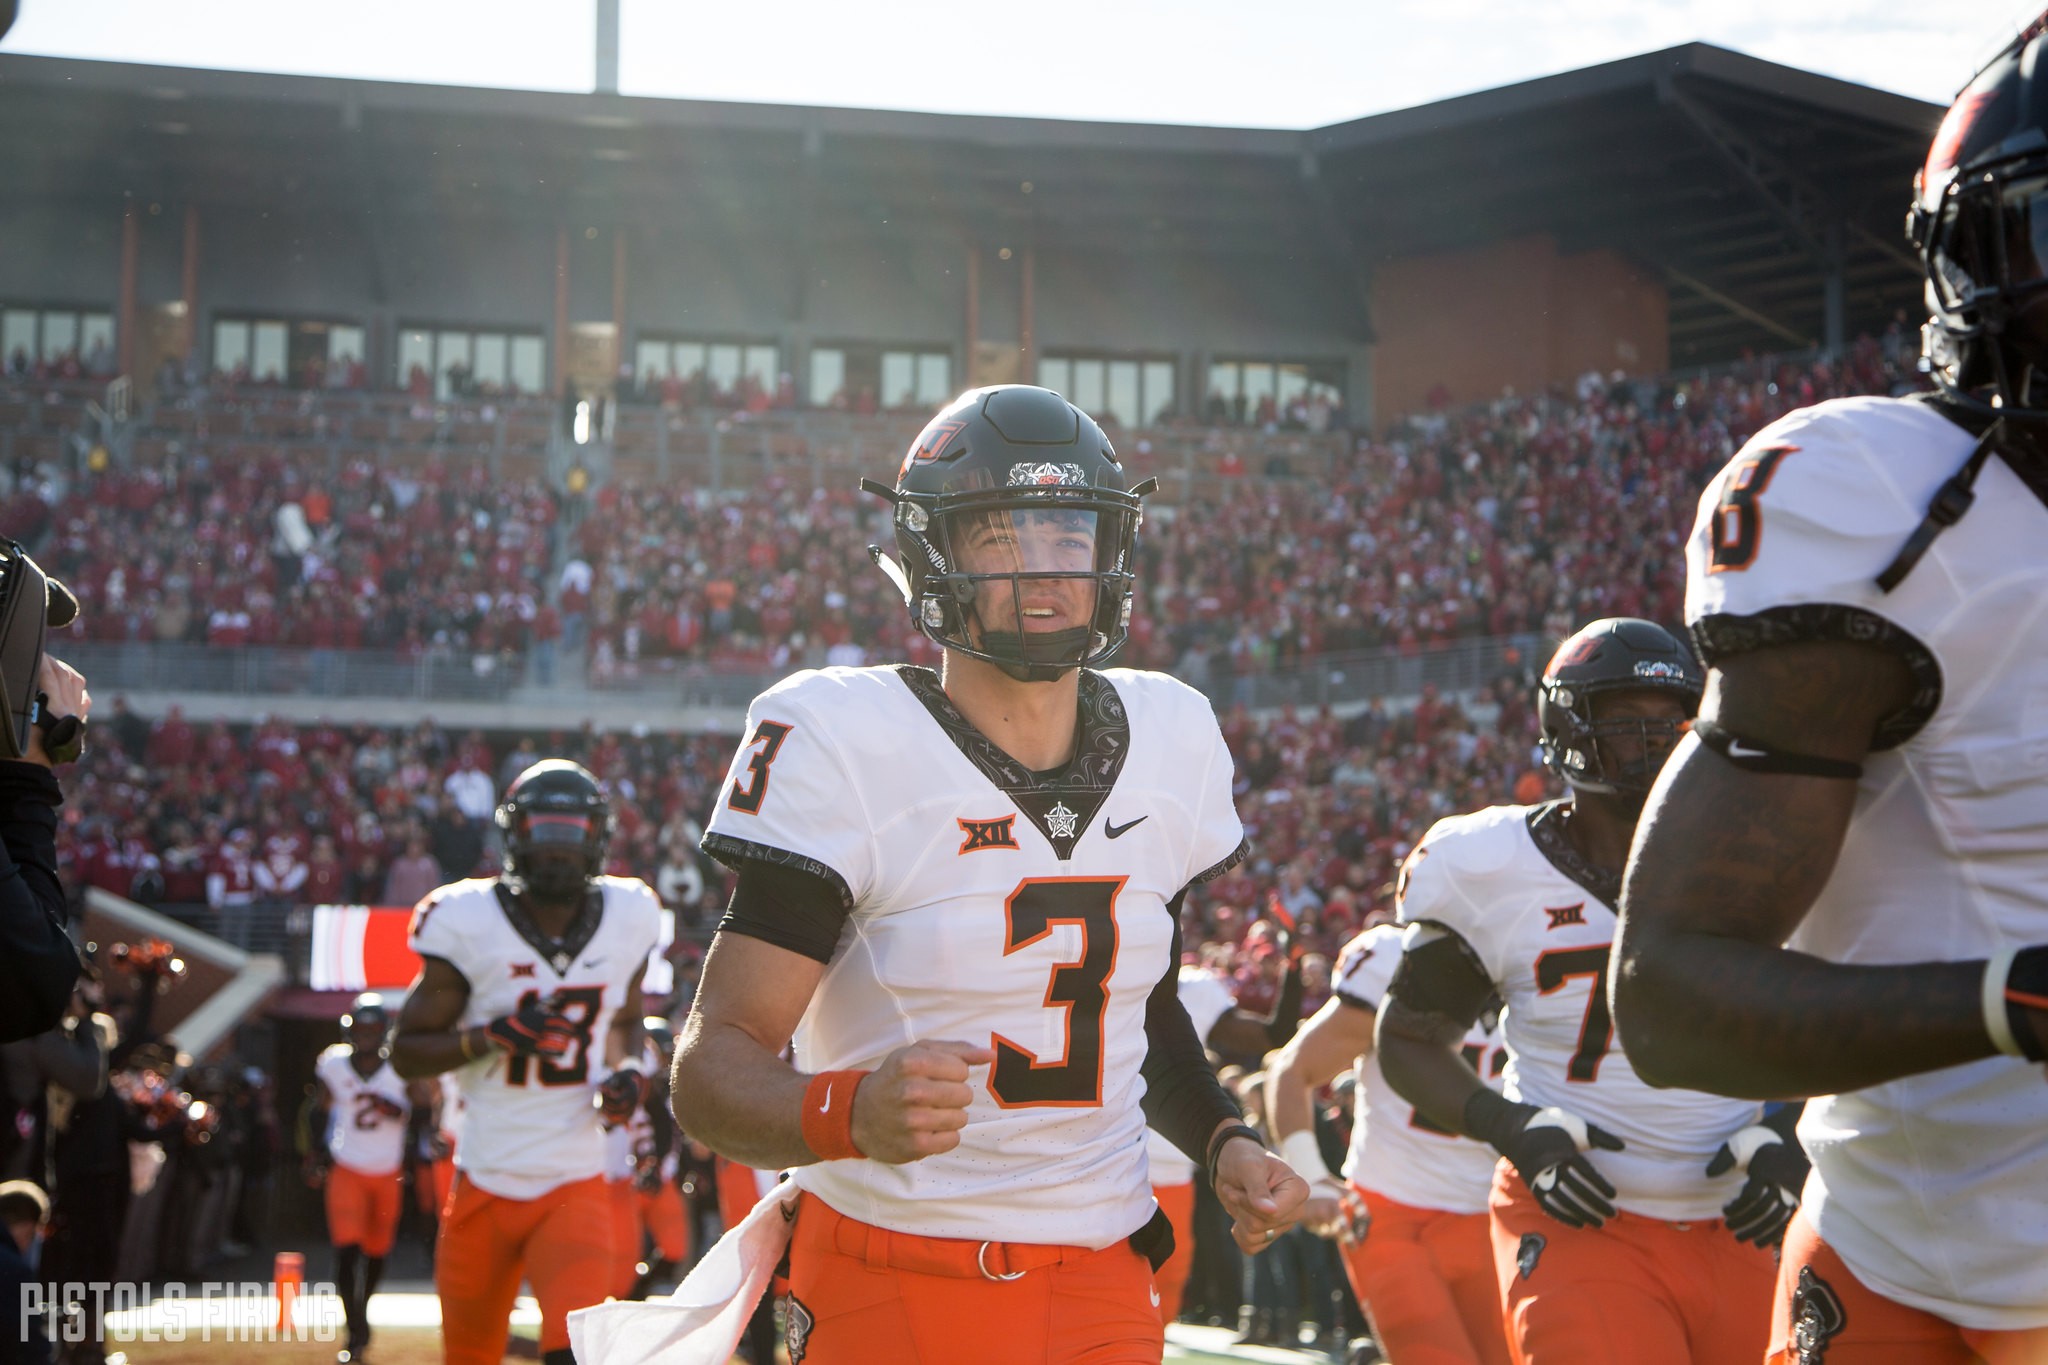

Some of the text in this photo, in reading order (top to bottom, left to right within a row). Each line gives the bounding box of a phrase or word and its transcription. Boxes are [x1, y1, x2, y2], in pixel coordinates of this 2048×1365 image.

[727, 718, 795, 817] 3
[958, 814, 1019, 854] XII
[986, 874, 1130, 1109] 3
